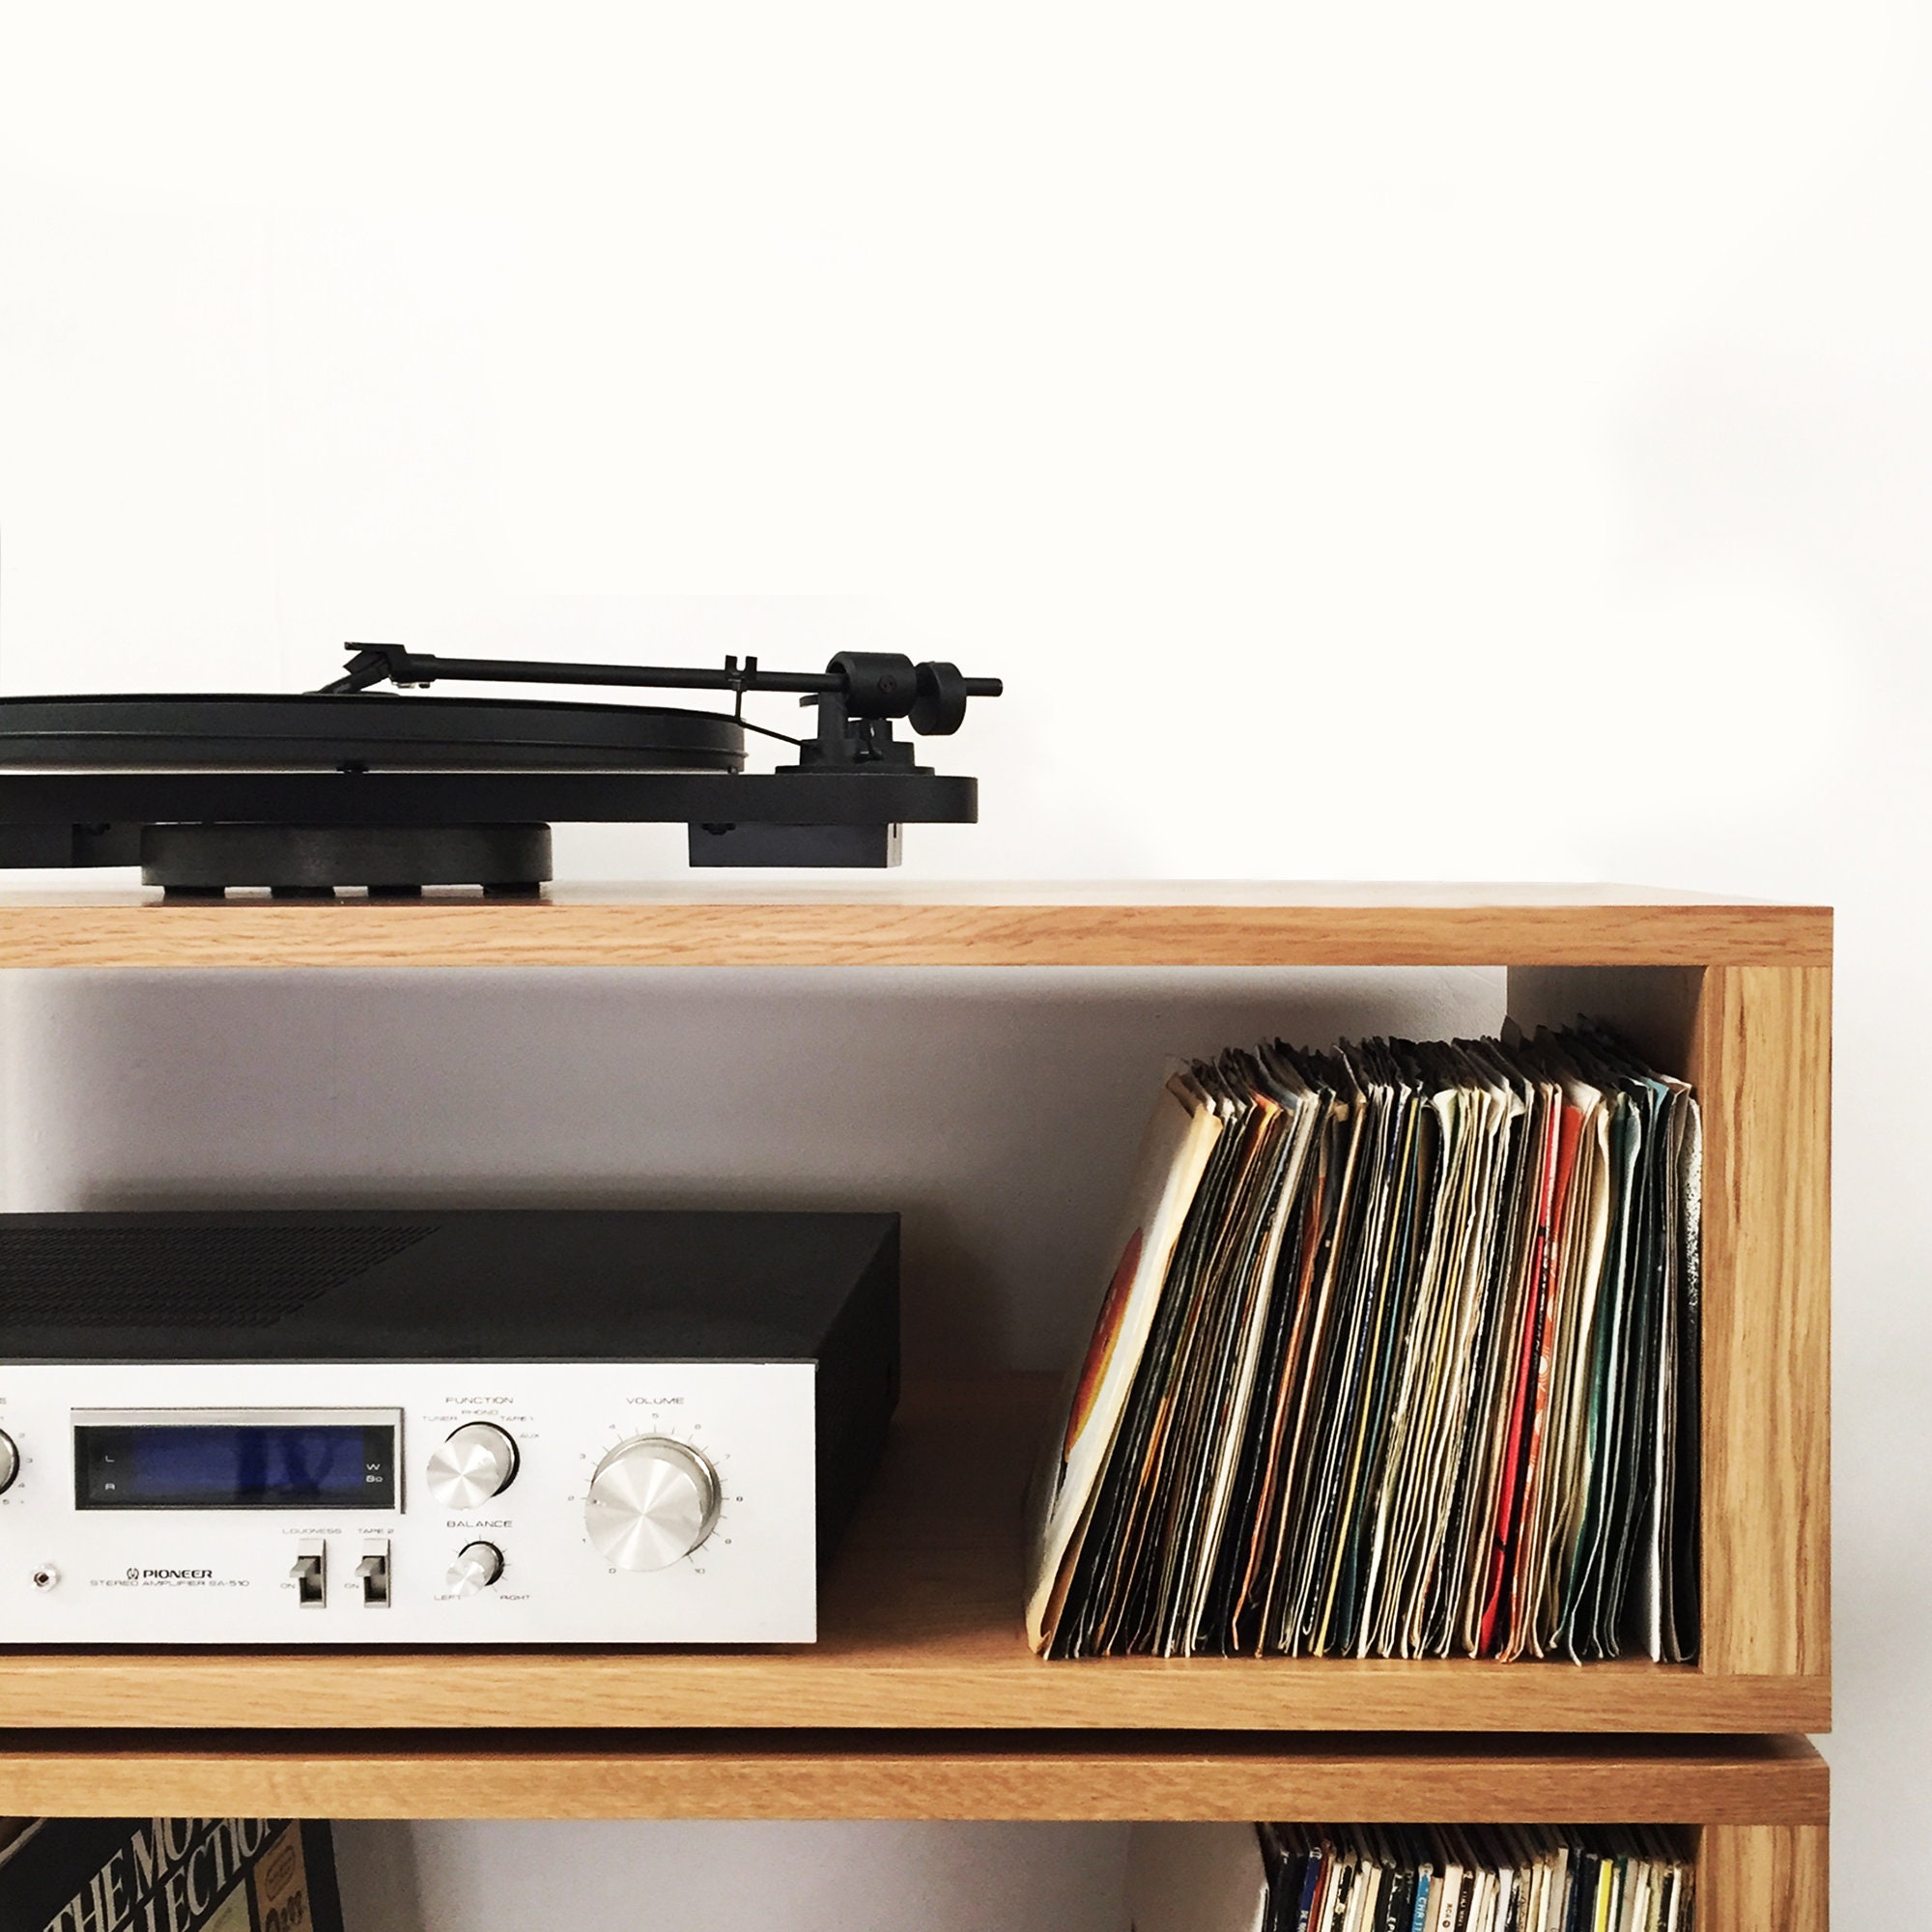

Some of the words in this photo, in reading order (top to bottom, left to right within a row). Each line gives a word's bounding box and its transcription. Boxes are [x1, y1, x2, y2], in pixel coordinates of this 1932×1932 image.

[444, 1396, 514, 1405] FUNCTION
[626, 1397, 684, 1406] VOLUME
[104, 1455, 115, 1463] L
[365, 1463, 381, 1471] W
[446, 1520, 513, 1528] BALANCE
[142, 1569, 213, 1579] PIONEER
